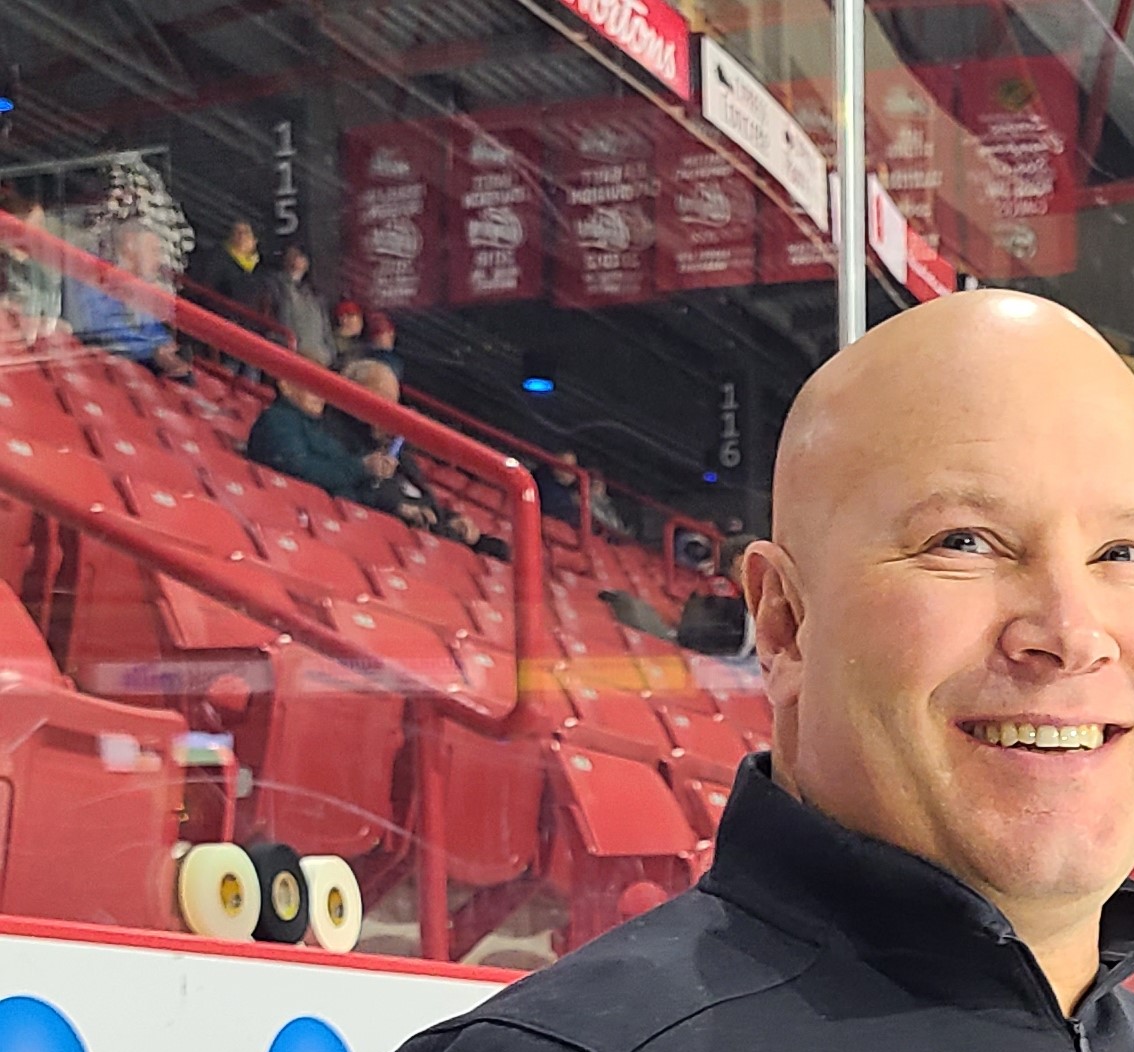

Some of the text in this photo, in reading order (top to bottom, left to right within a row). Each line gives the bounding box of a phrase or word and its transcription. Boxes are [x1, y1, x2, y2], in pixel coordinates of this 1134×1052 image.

[565, 0, 676, 80] ortons
[274, 121, 299, 235] 115
[720, 383, 741, 468] 116
